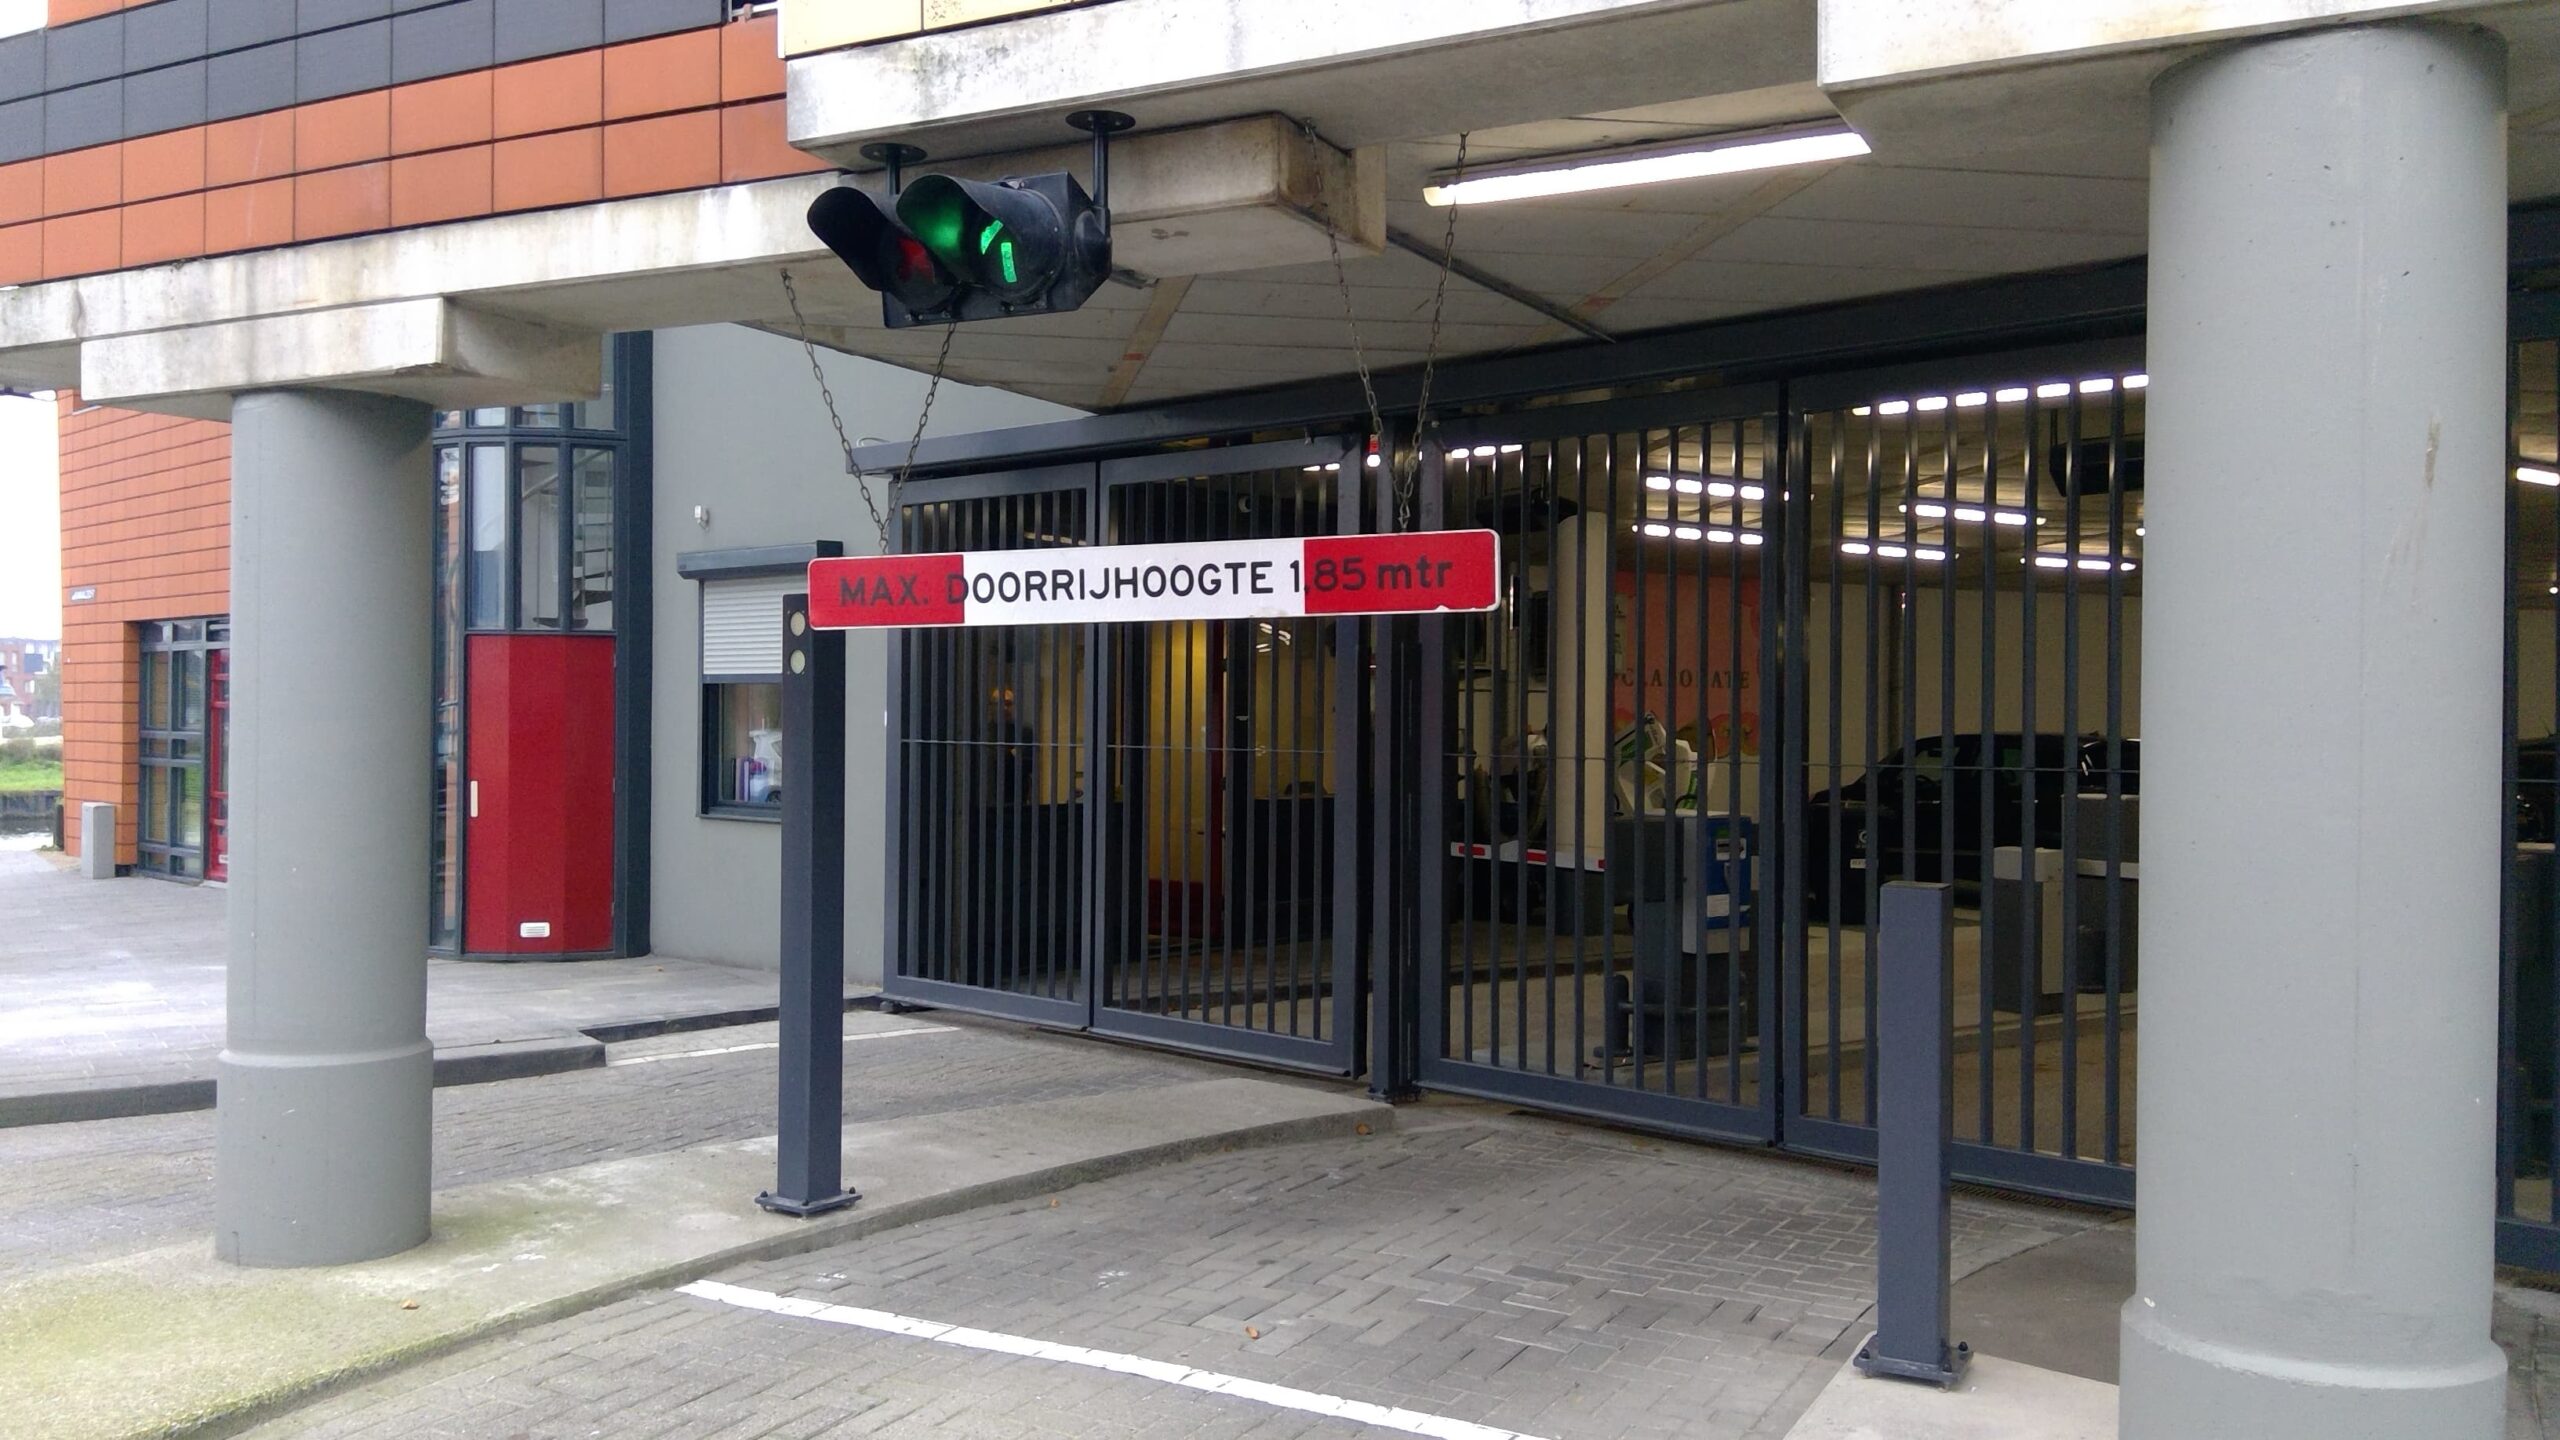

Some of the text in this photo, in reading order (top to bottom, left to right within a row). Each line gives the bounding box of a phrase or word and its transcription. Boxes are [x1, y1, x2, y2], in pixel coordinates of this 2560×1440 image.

[839, 574, 929, 607] MAX.
[946, 560, 1274, 604] DOORRIJHOOGTE
[1377, 555, 1453, 589] mtr
